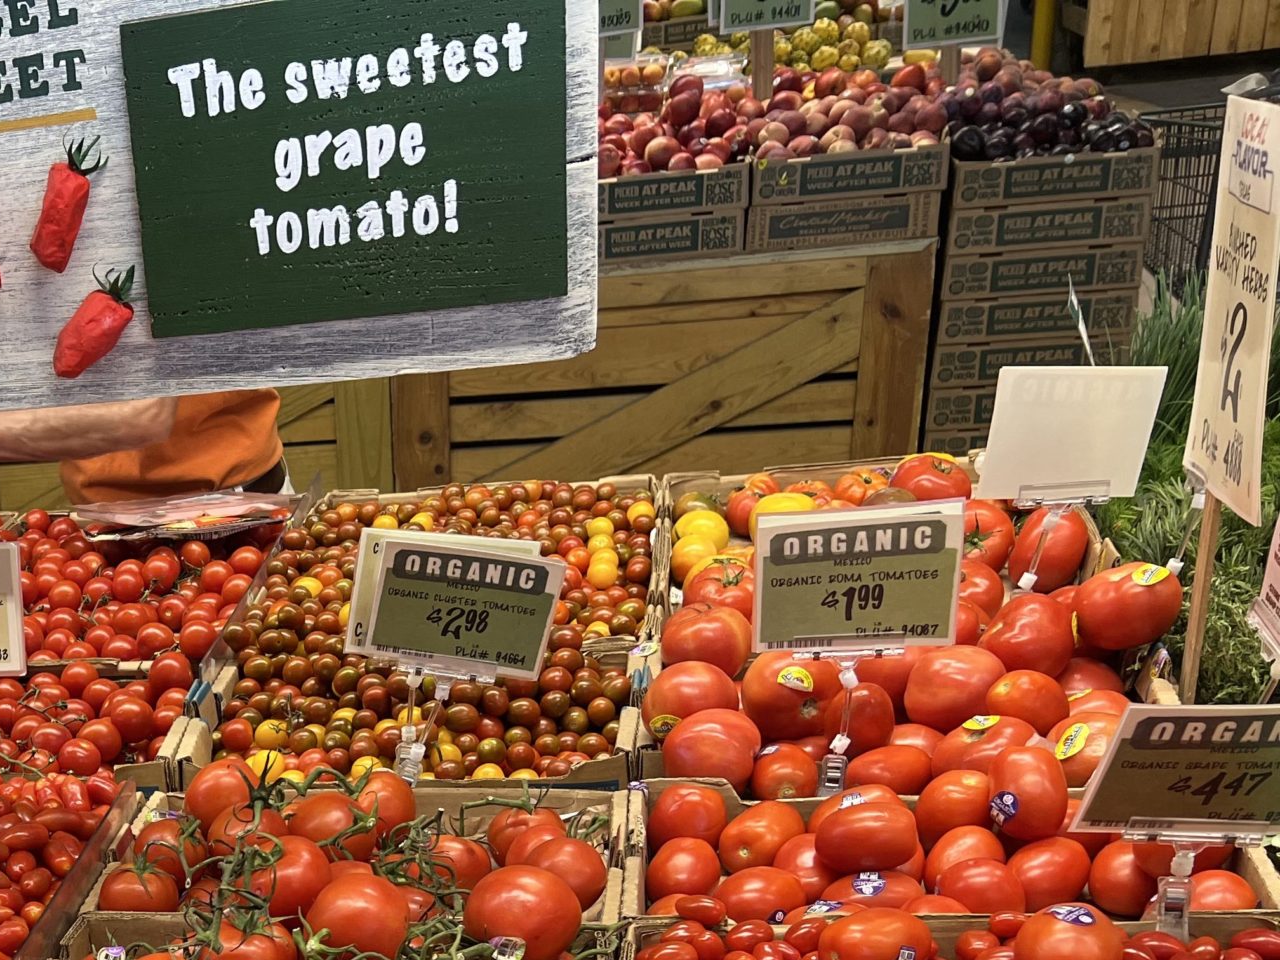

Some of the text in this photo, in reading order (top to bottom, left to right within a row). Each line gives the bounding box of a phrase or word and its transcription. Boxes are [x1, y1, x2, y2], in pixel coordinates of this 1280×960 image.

[913, 29, 936, 40] PLU
[168, 22, 528, 120] The sweetest
[1242, 112, 1268, 145] LOCAL
[274, 119, 427, 192] grape
[836, 164, 853, 177] AT
[856, 161, 894, 174] PEAK
[1233, 140, 1269, 179] FLAVOR
[1042, 167, 1060, 180] AT
[1064, 164, 1103, 179] PEAK
[642, 183, 658, 196] AT
[660, 181, 696, 194] PEAK
[250, 179, 458, 255] tomato!
[1242, 265, 1269, 303] HERBS
[783, 525, 933, 557] ORGANIC
[405, 554, 536, 590] ORGANIC
[833, 557, 872, 567] MEXICO
[446, 581, 481, 592] MEXICO
[771, 569, 939, 588] ORGANIC ROMA TOMATOES
[388, 587, 537, 617] ORGANIC CLUSTER TOMATOES
[821, 583, 884, 622] $199
[1121, 760, 1228, 770] ORGANIC GRAPE
